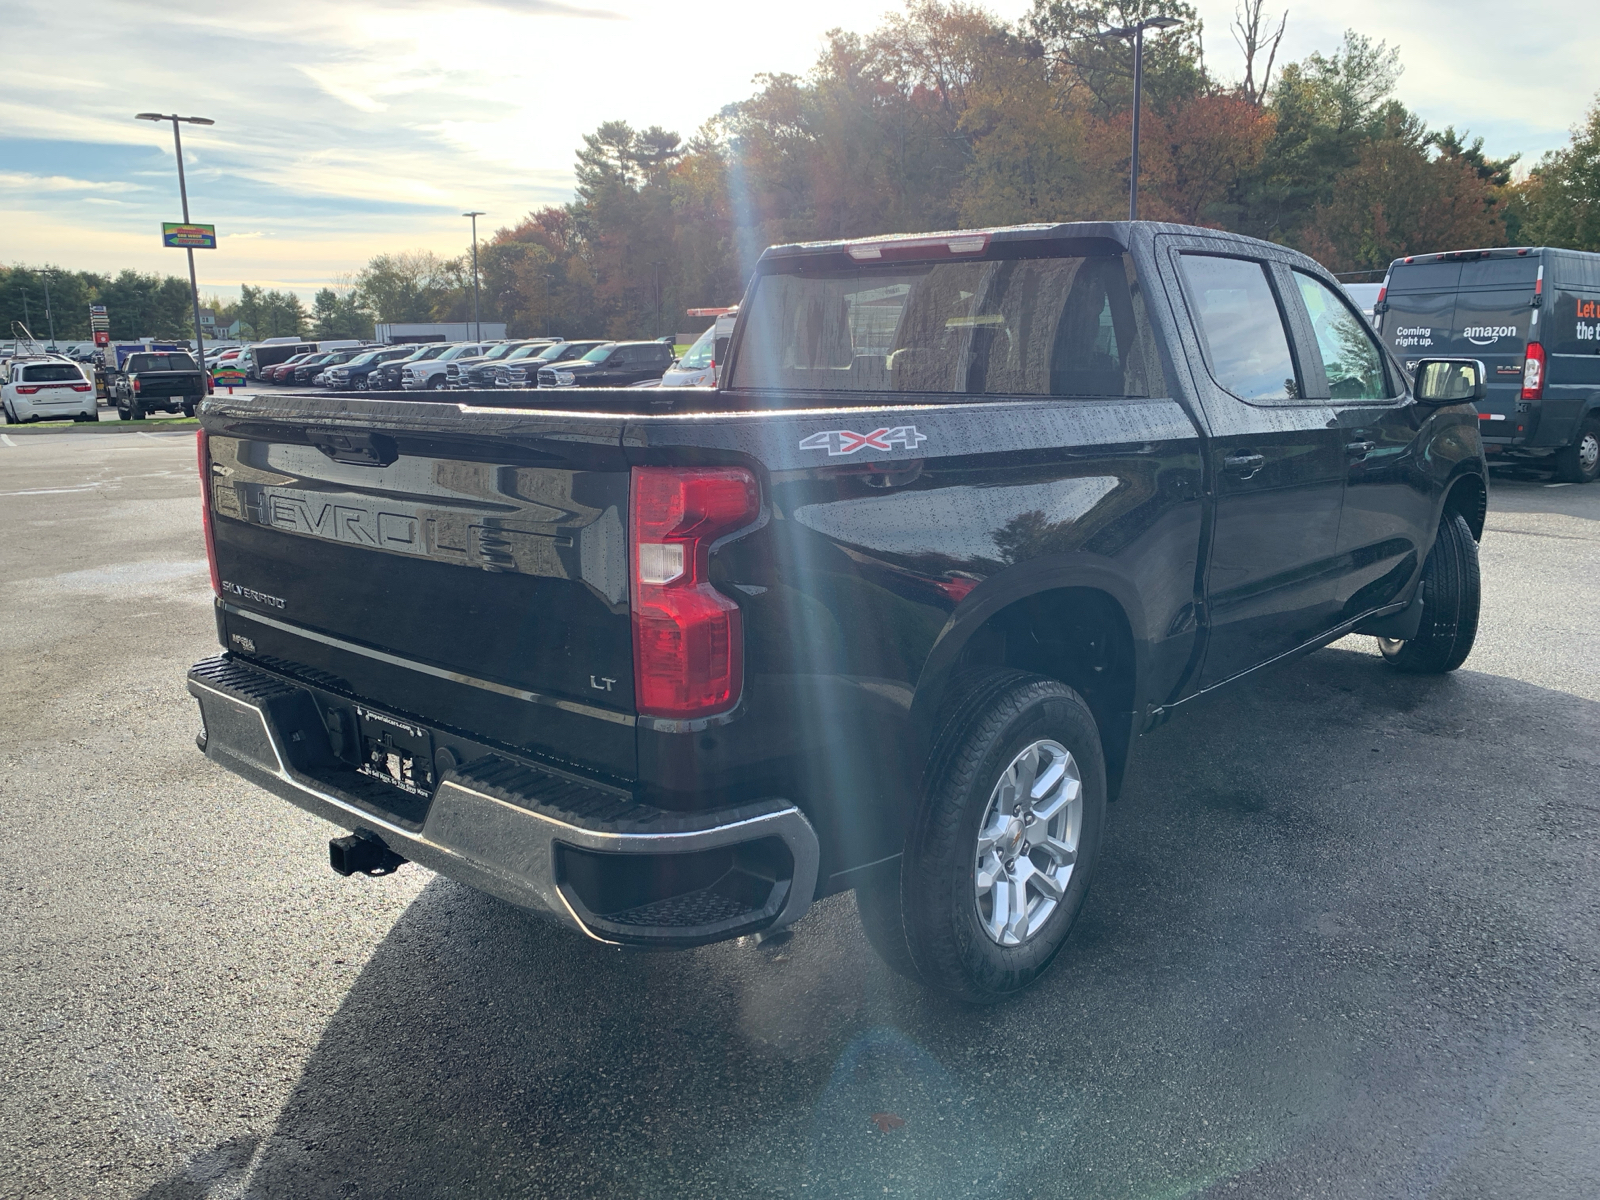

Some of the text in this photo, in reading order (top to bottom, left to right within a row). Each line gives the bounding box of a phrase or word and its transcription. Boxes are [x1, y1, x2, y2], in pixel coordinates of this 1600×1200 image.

[1577, 299, 1595, 318] Let
[1397, 326, 1431, 337] Coming
[1463, 325, 1517, 338] amazon
[1576, 321, 1594, 340] the
[1395, 337, 1434, 347] right up.
[216, 484, 574, 573] CHEVROLET
[222, 580, 287, 609] SILVERADO
[590, 675, 617, 691] LT
